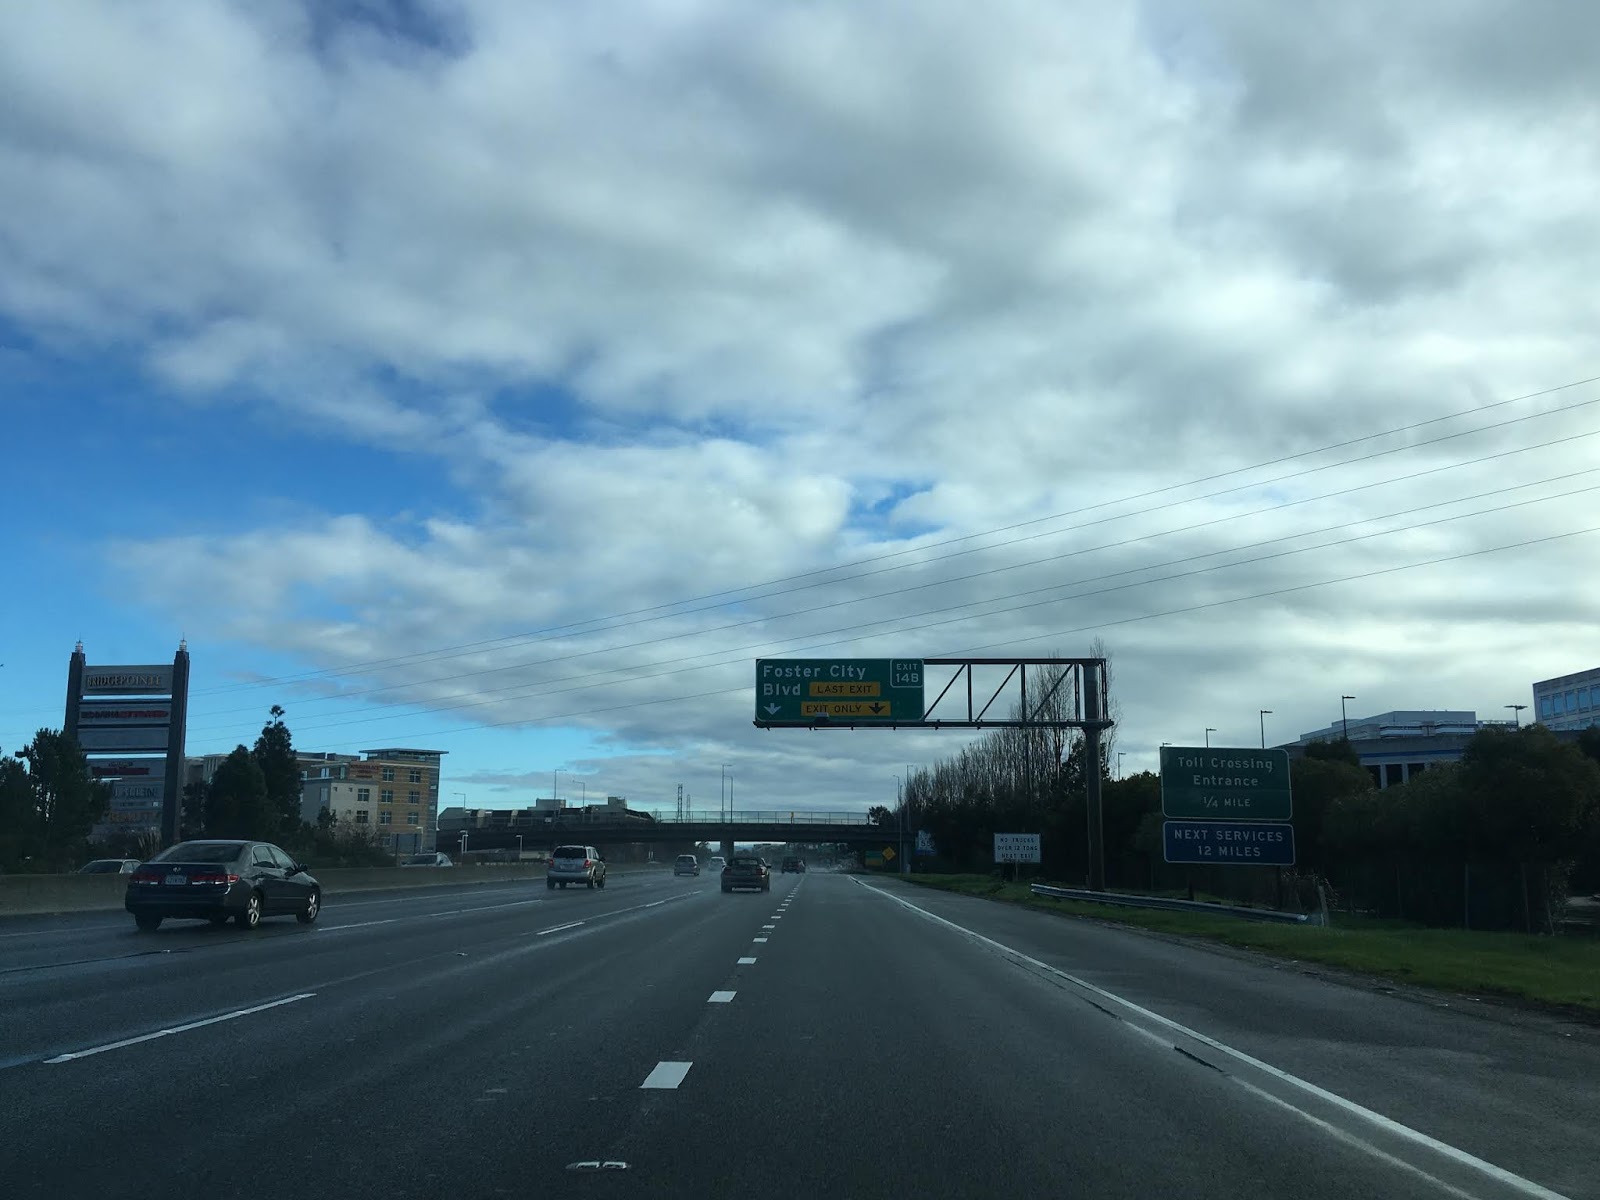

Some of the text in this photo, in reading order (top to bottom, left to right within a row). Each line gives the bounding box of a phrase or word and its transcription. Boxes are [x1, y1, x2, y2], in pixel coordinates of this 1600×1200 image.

[763, 665, 867, 680] Foster City
[896, 663, 918, 671] EXIT
[895, 673, 919, 683] 14B
[763, 683, 801, 696] Blvd
[817, 685, 872, 694] LAST EXIT
[806, 704, 862, 713] EXIT ONLY
[1178, 757, 1274, 773] Toll Crossing
[1193, 775, 1259, 786] Entrance
[1224, 798, 1251, 807] MILE
[1174, 829, 1283, 842] NEXT SERVICES
[1198, 845, 1261, 857] 12 MILES
